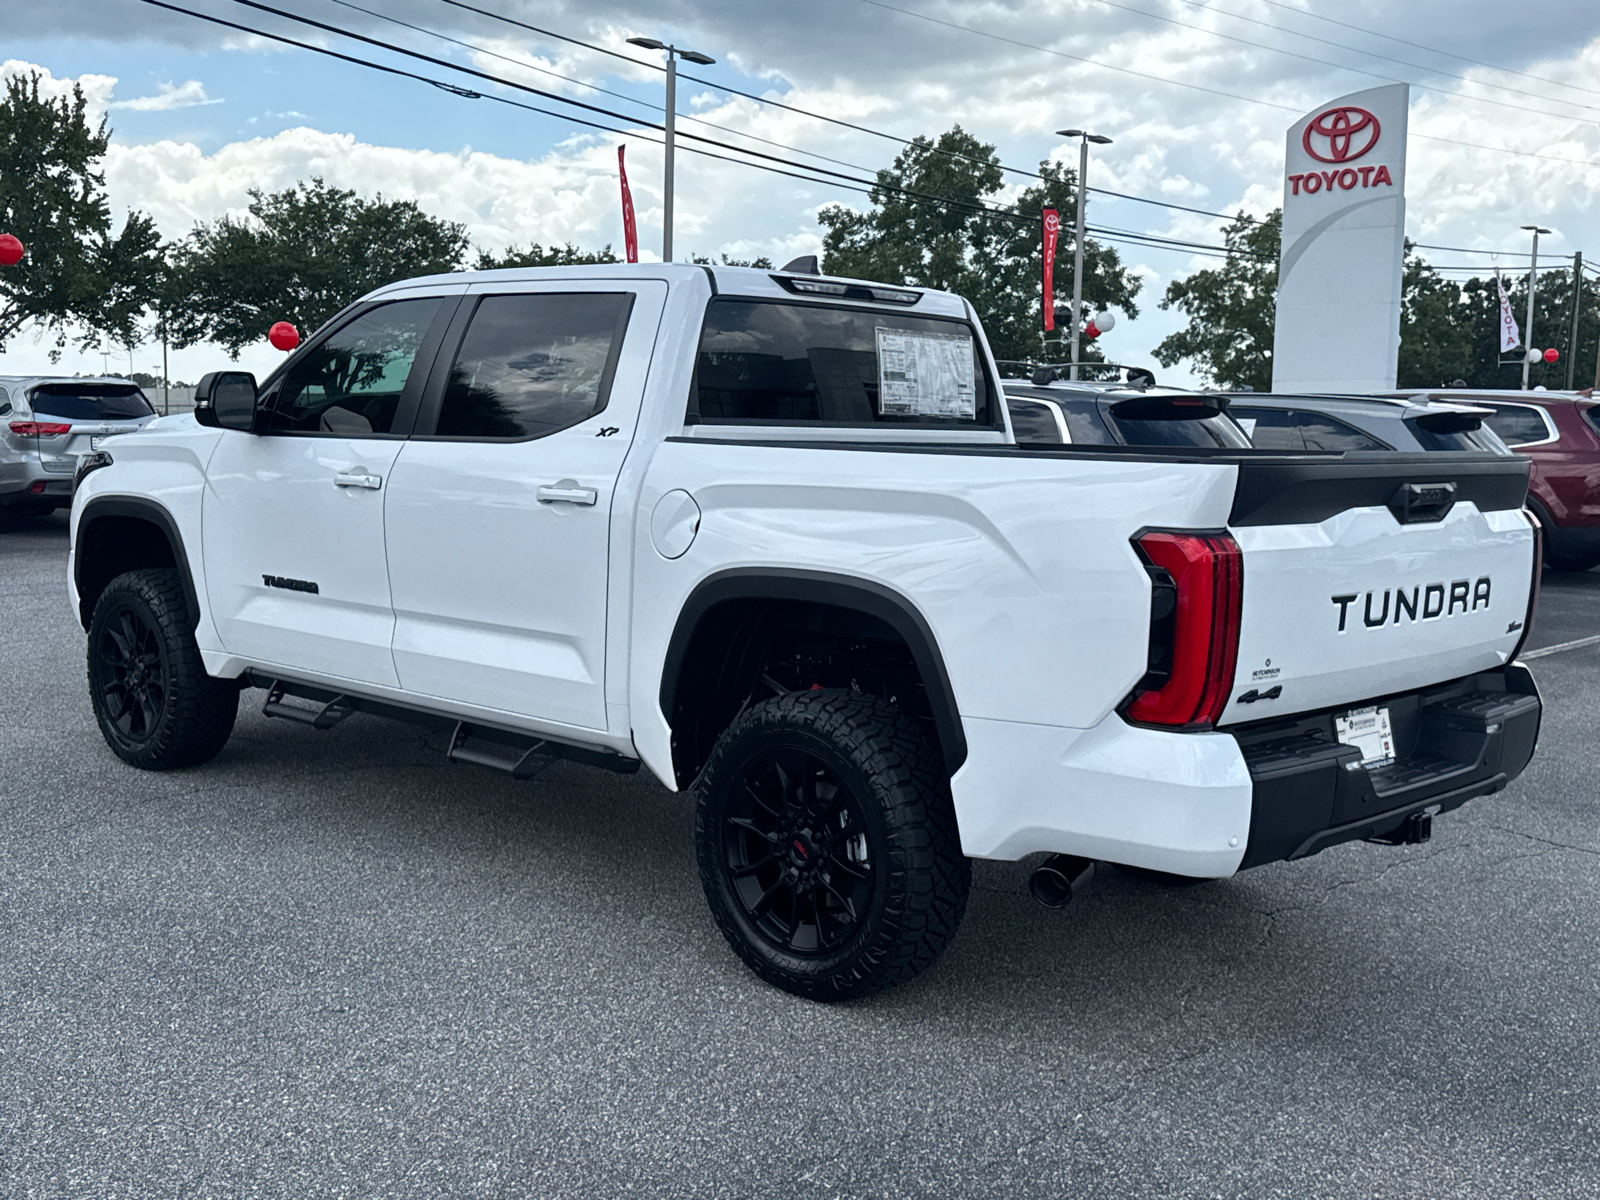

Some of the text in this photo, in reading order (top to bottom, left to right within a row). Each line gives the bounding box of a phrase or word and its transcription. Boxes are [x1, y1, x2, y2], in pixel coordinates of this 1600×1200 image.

[1288, 165, 1392, 196] TOYOTA
[1498, 286, 1516, 346] TOYOTA
[261, 574, 319, 595] TUNDRA
[1331, 576, 1491, 633] TUNDRA
